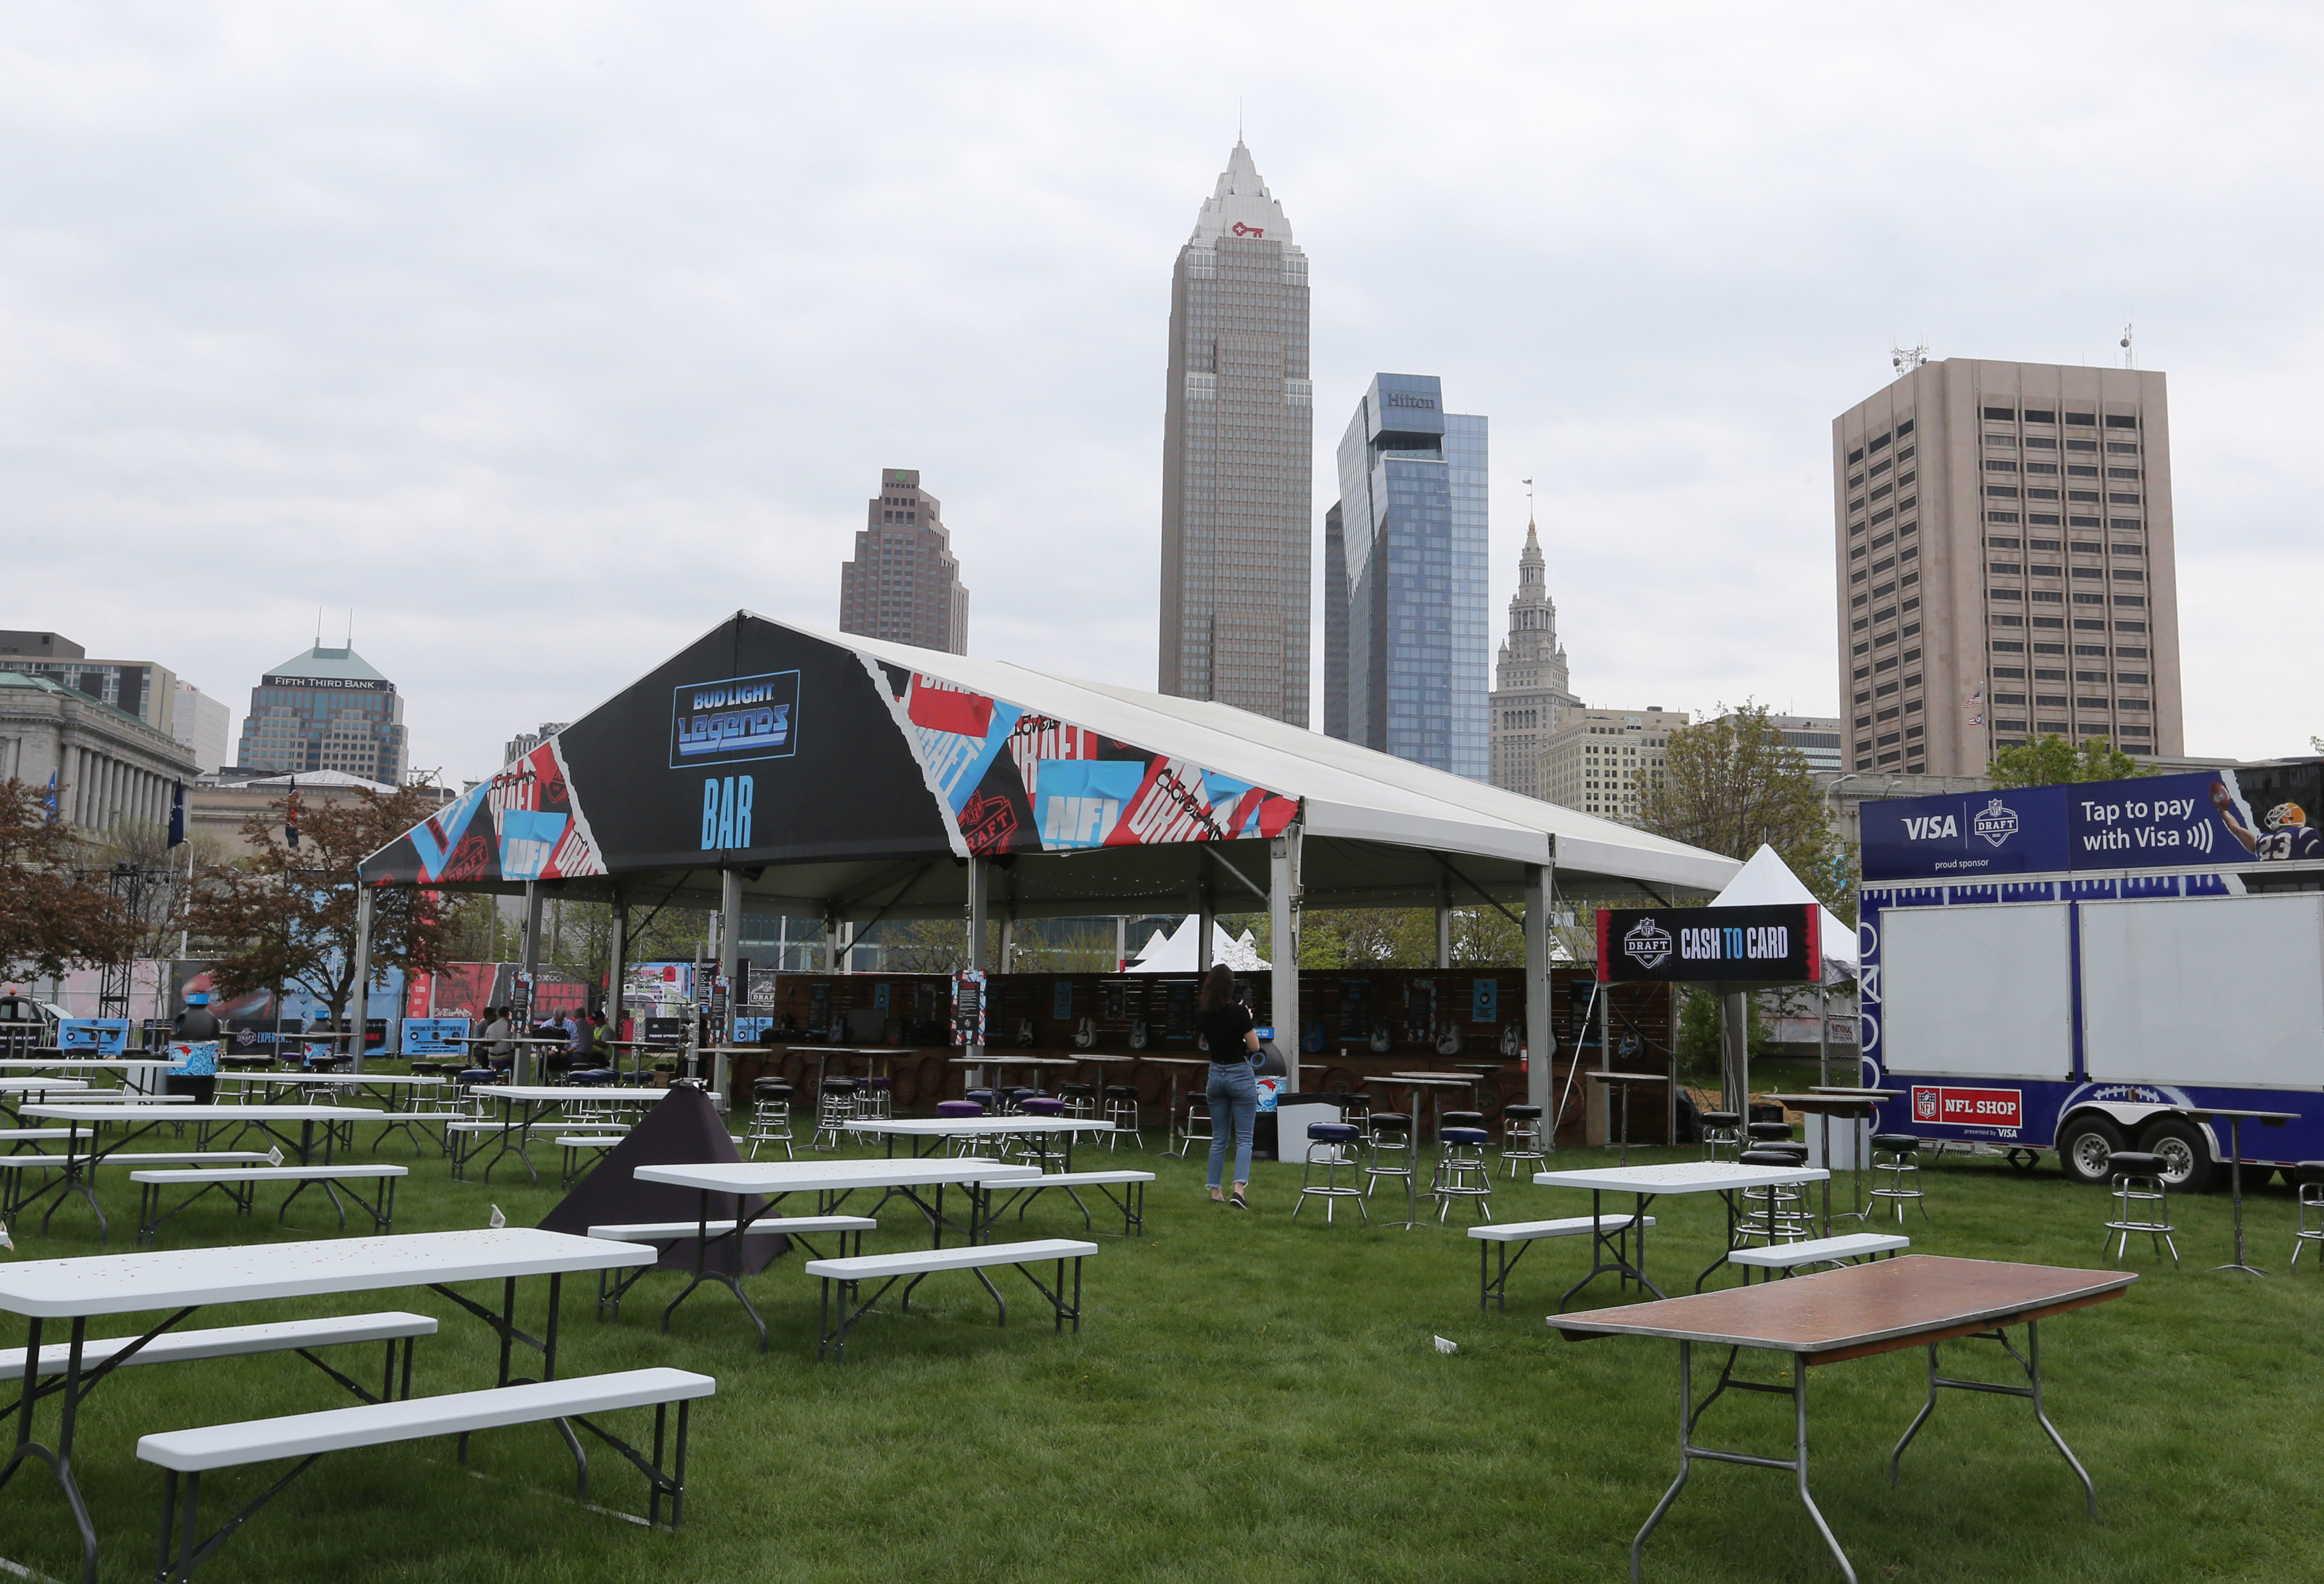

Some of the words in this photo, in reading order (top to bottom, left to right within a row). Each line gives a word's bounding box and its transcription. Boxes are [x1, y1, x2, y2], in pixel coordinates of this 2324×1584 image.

[1388, 394, 1435, 409] Hilton
[275, 677, 305, 686] FIFTH
[308, 678, 342, 687] THIRD
[344, 680, 374, 689] BANK
[693, 689, 726, 710] BUD
[727, 683, 774, 706] LIGHT
[701, 774, 754, 851] BAR
[1990, 807, 2001, 815] NFL
[2080, 801, 2120, 825] Tap
[2125, 800, 2148, 819] to
[2154, 798, 2195, 822] pay
[966, 811, 1008, 851] RAFT
[1901, 814, 1958, 840] VISA
[1978, 819, 2015, 831] DRAFT
[2083, 828, 2130, 851] with
[2134, 825, 2180, 848] Visa
[2259, 832, 2292, 862] 23
[1935, 859, 1957, 871] proud
[1959, 859, 1989, 869] sponsor
[1642, 926, 1653, 935] NFL
[1628, 941, 1668, 950] DRAFT
[1681, 928, 1721, 959] CASH
[1723, 928, 1743, 959] TO
[1747, 926, 1788, 959] CARD
[536, 983, 570, 996] AKE
[1920, 1102, 1934, 1114] NFL
[1945, 1099, 1973, 1113] NFL
[1976, 1100, 2016, 1115] SHOP
[1997, 1128, 2017, 1138] VISA
